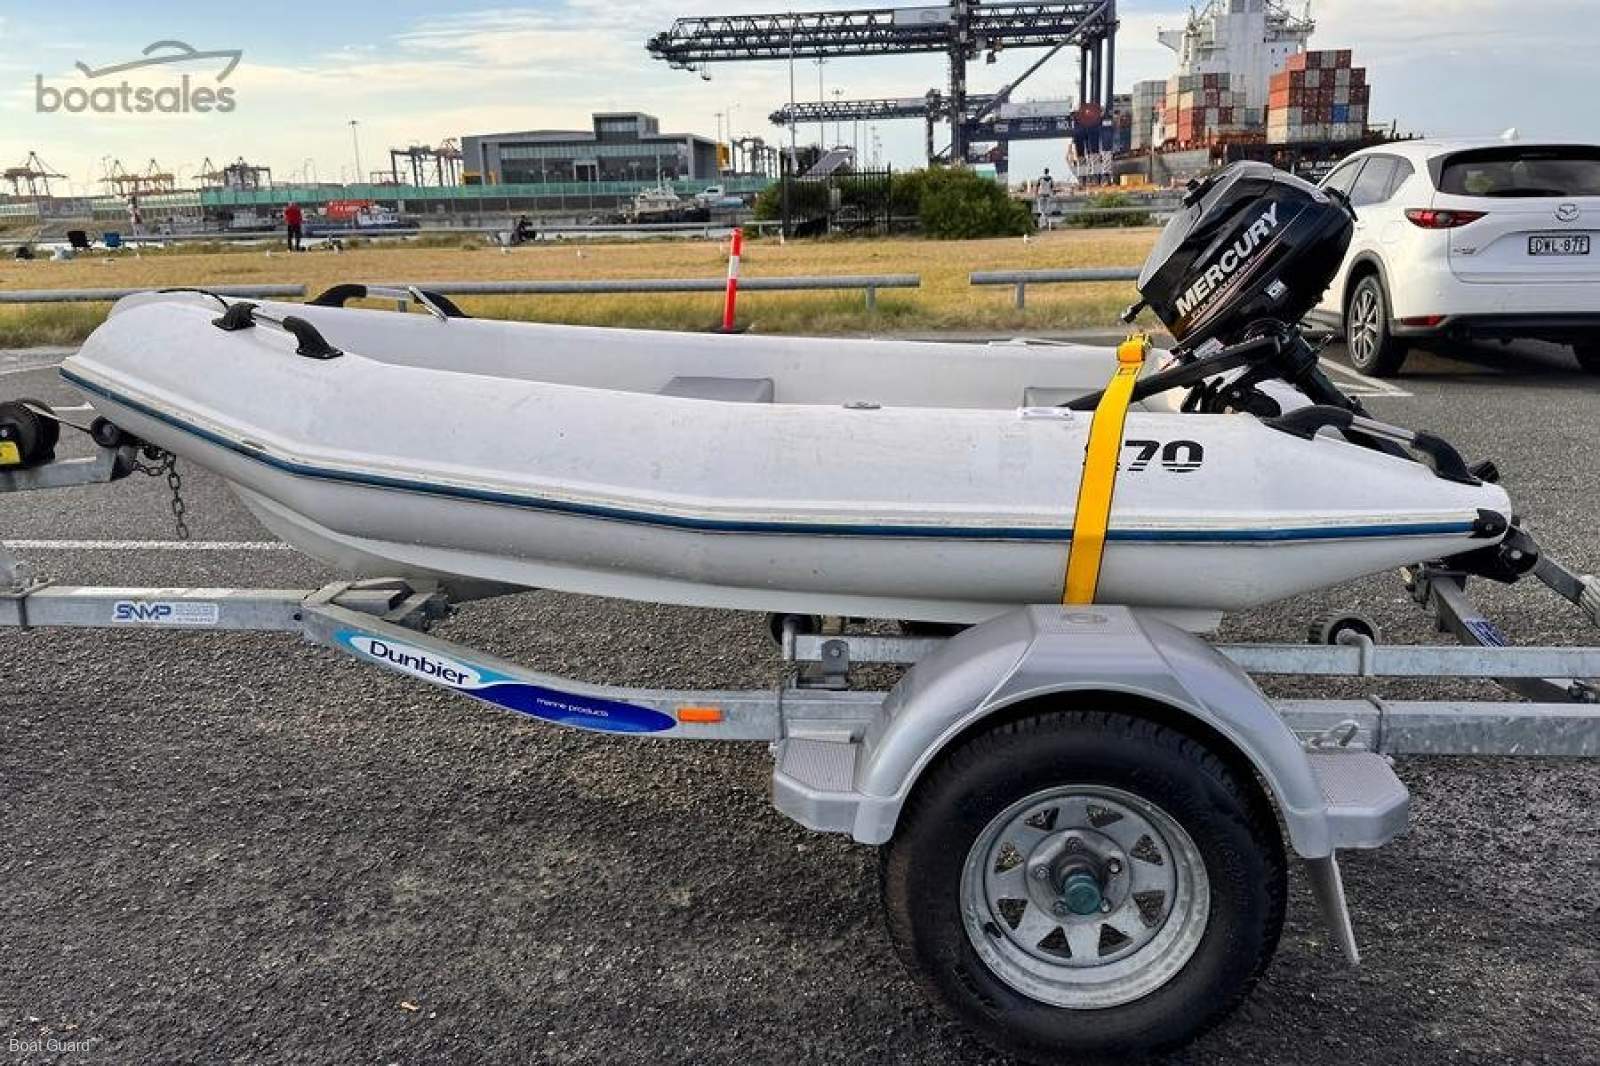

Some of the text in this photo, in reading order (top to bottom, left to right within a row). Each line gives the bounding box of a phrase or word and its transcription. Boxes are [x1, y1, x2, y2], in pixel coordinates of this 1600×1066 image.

[1174, 202, 1278, 318] MERCURY
[1083, 440, 1204, 473] 70
[369, 640, 470, 685] Dunbier
[536, 698, 609, 717] marine products
